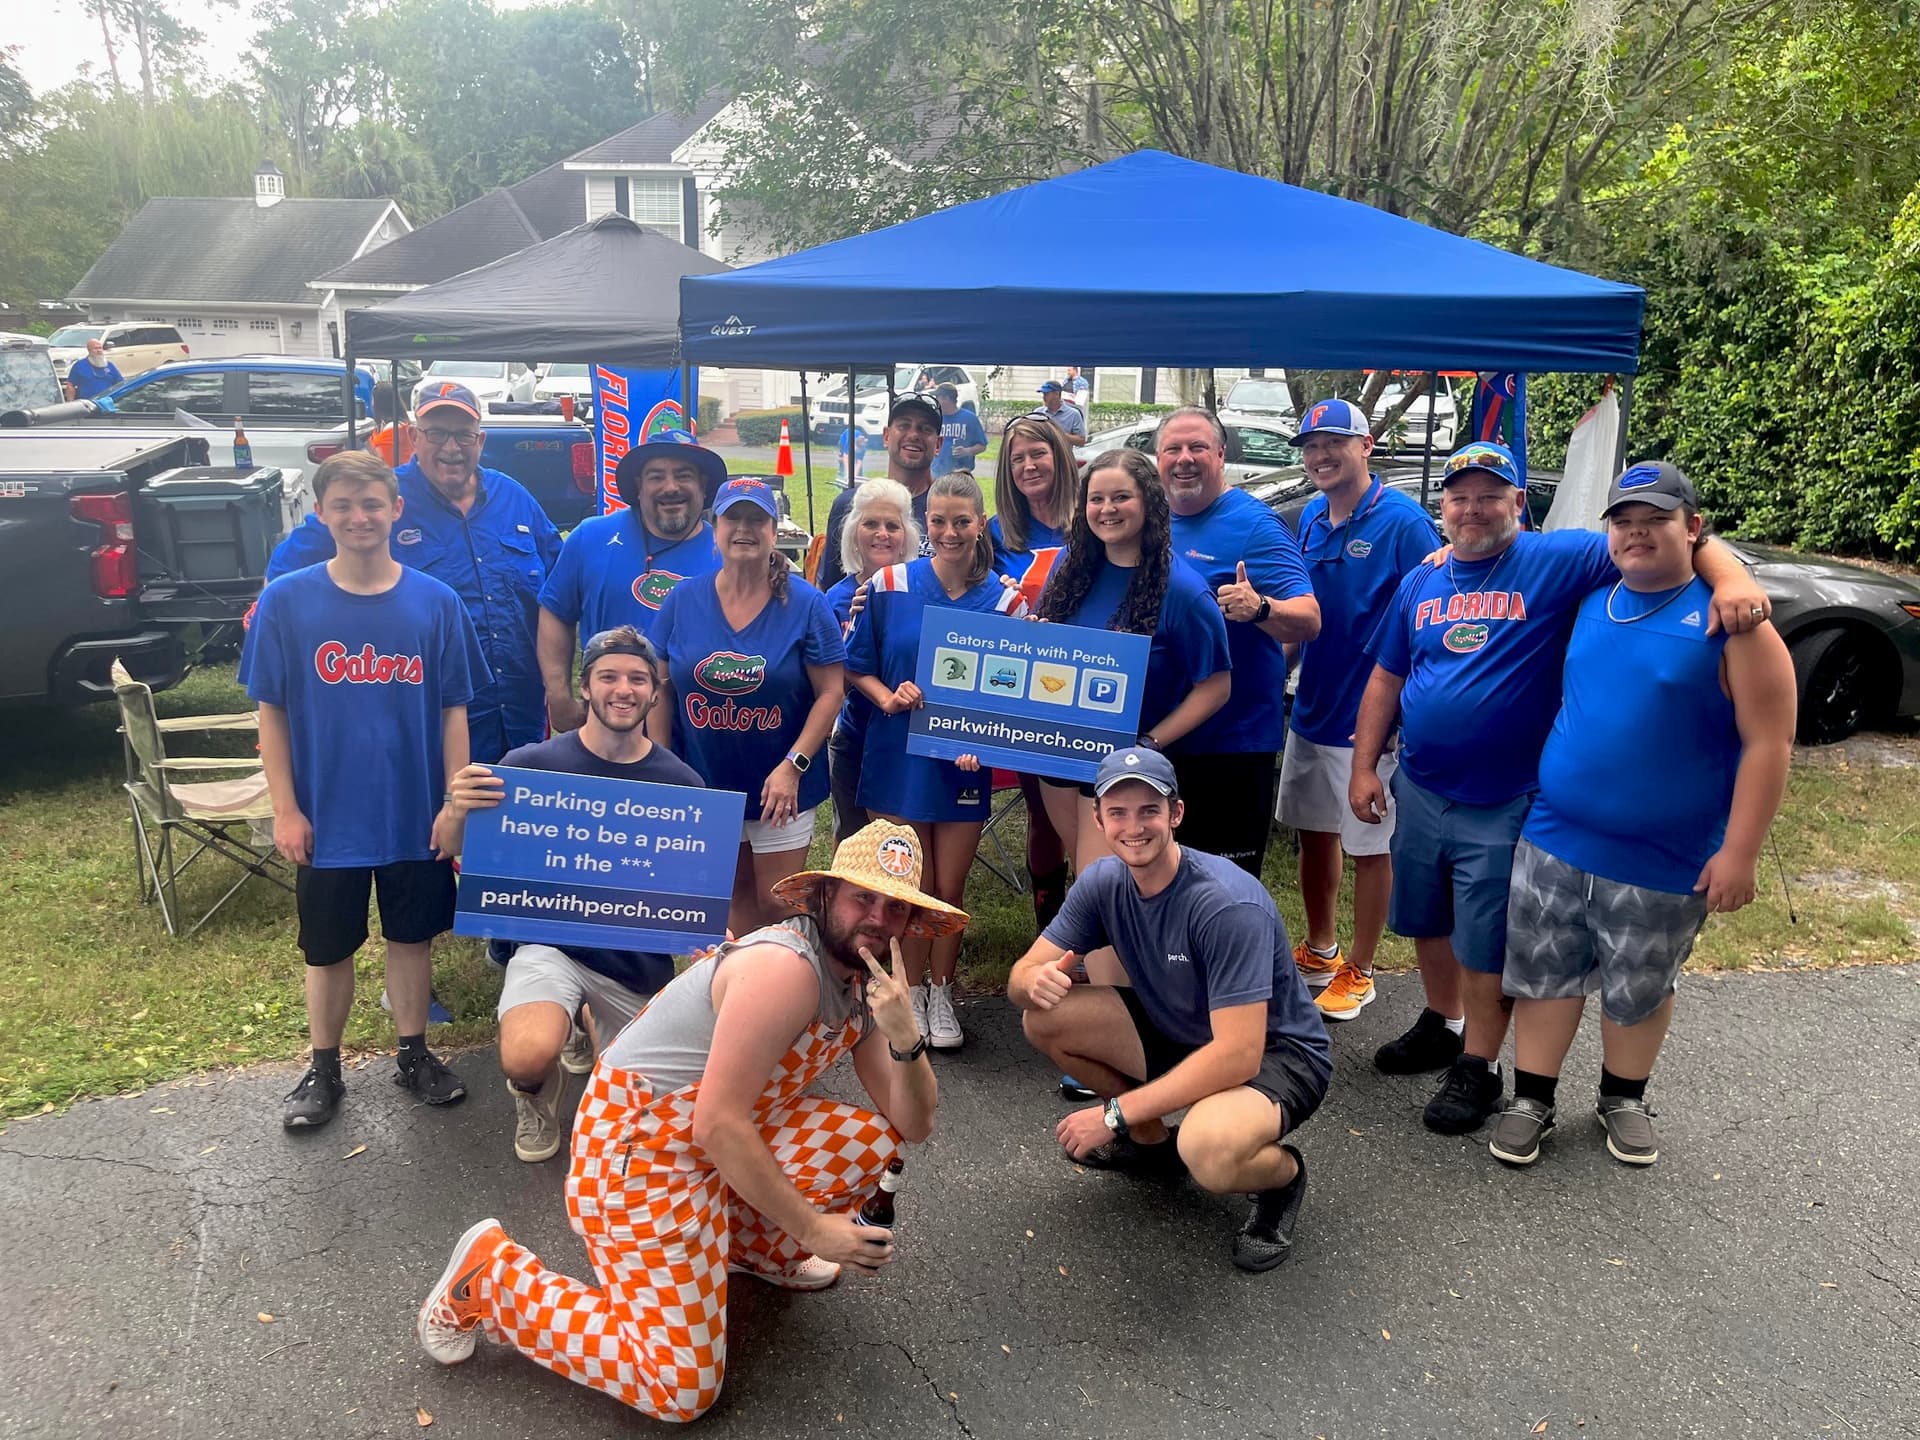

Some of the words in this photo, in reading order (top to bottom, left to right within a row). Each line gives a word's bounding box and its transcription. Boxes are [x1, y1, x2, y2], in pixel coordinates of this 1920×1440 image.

[710, 325, 757, 336] QUEST
[440, 384, 456, 397] F
[939, 423, 967, 441] ORIDA
[1311, 405, 1329, 427] F
[1415, 591, 1527, 630] FLORIDA
[314, 640, 424, 684] Gators
[946, 631, 995, 650] Gators
[999, 639, 1032, 655] Park
[1036, 645, 1068, 660] with
[1072, 650, 1120, 668] Perch.
[685, 692, 782, 731] Gators
[928, 715, 1114, 755] parkwithperch.com
[514, 787, 607, 818] Parking
[613, 798, 703, 824] doesn't
[501, 815, 559, 838] have
[566, 823, 590, 841] to
[597, 825, 628, 845] be
[635, 834, 648, 848] a
[655, 834, 706, 854] pain
[545, 850, 567, 869] in
[574, 853, 613, 873] the
[887, 842, 910, 868] T
[480, 889, 707, 924] parkwithperch.com
